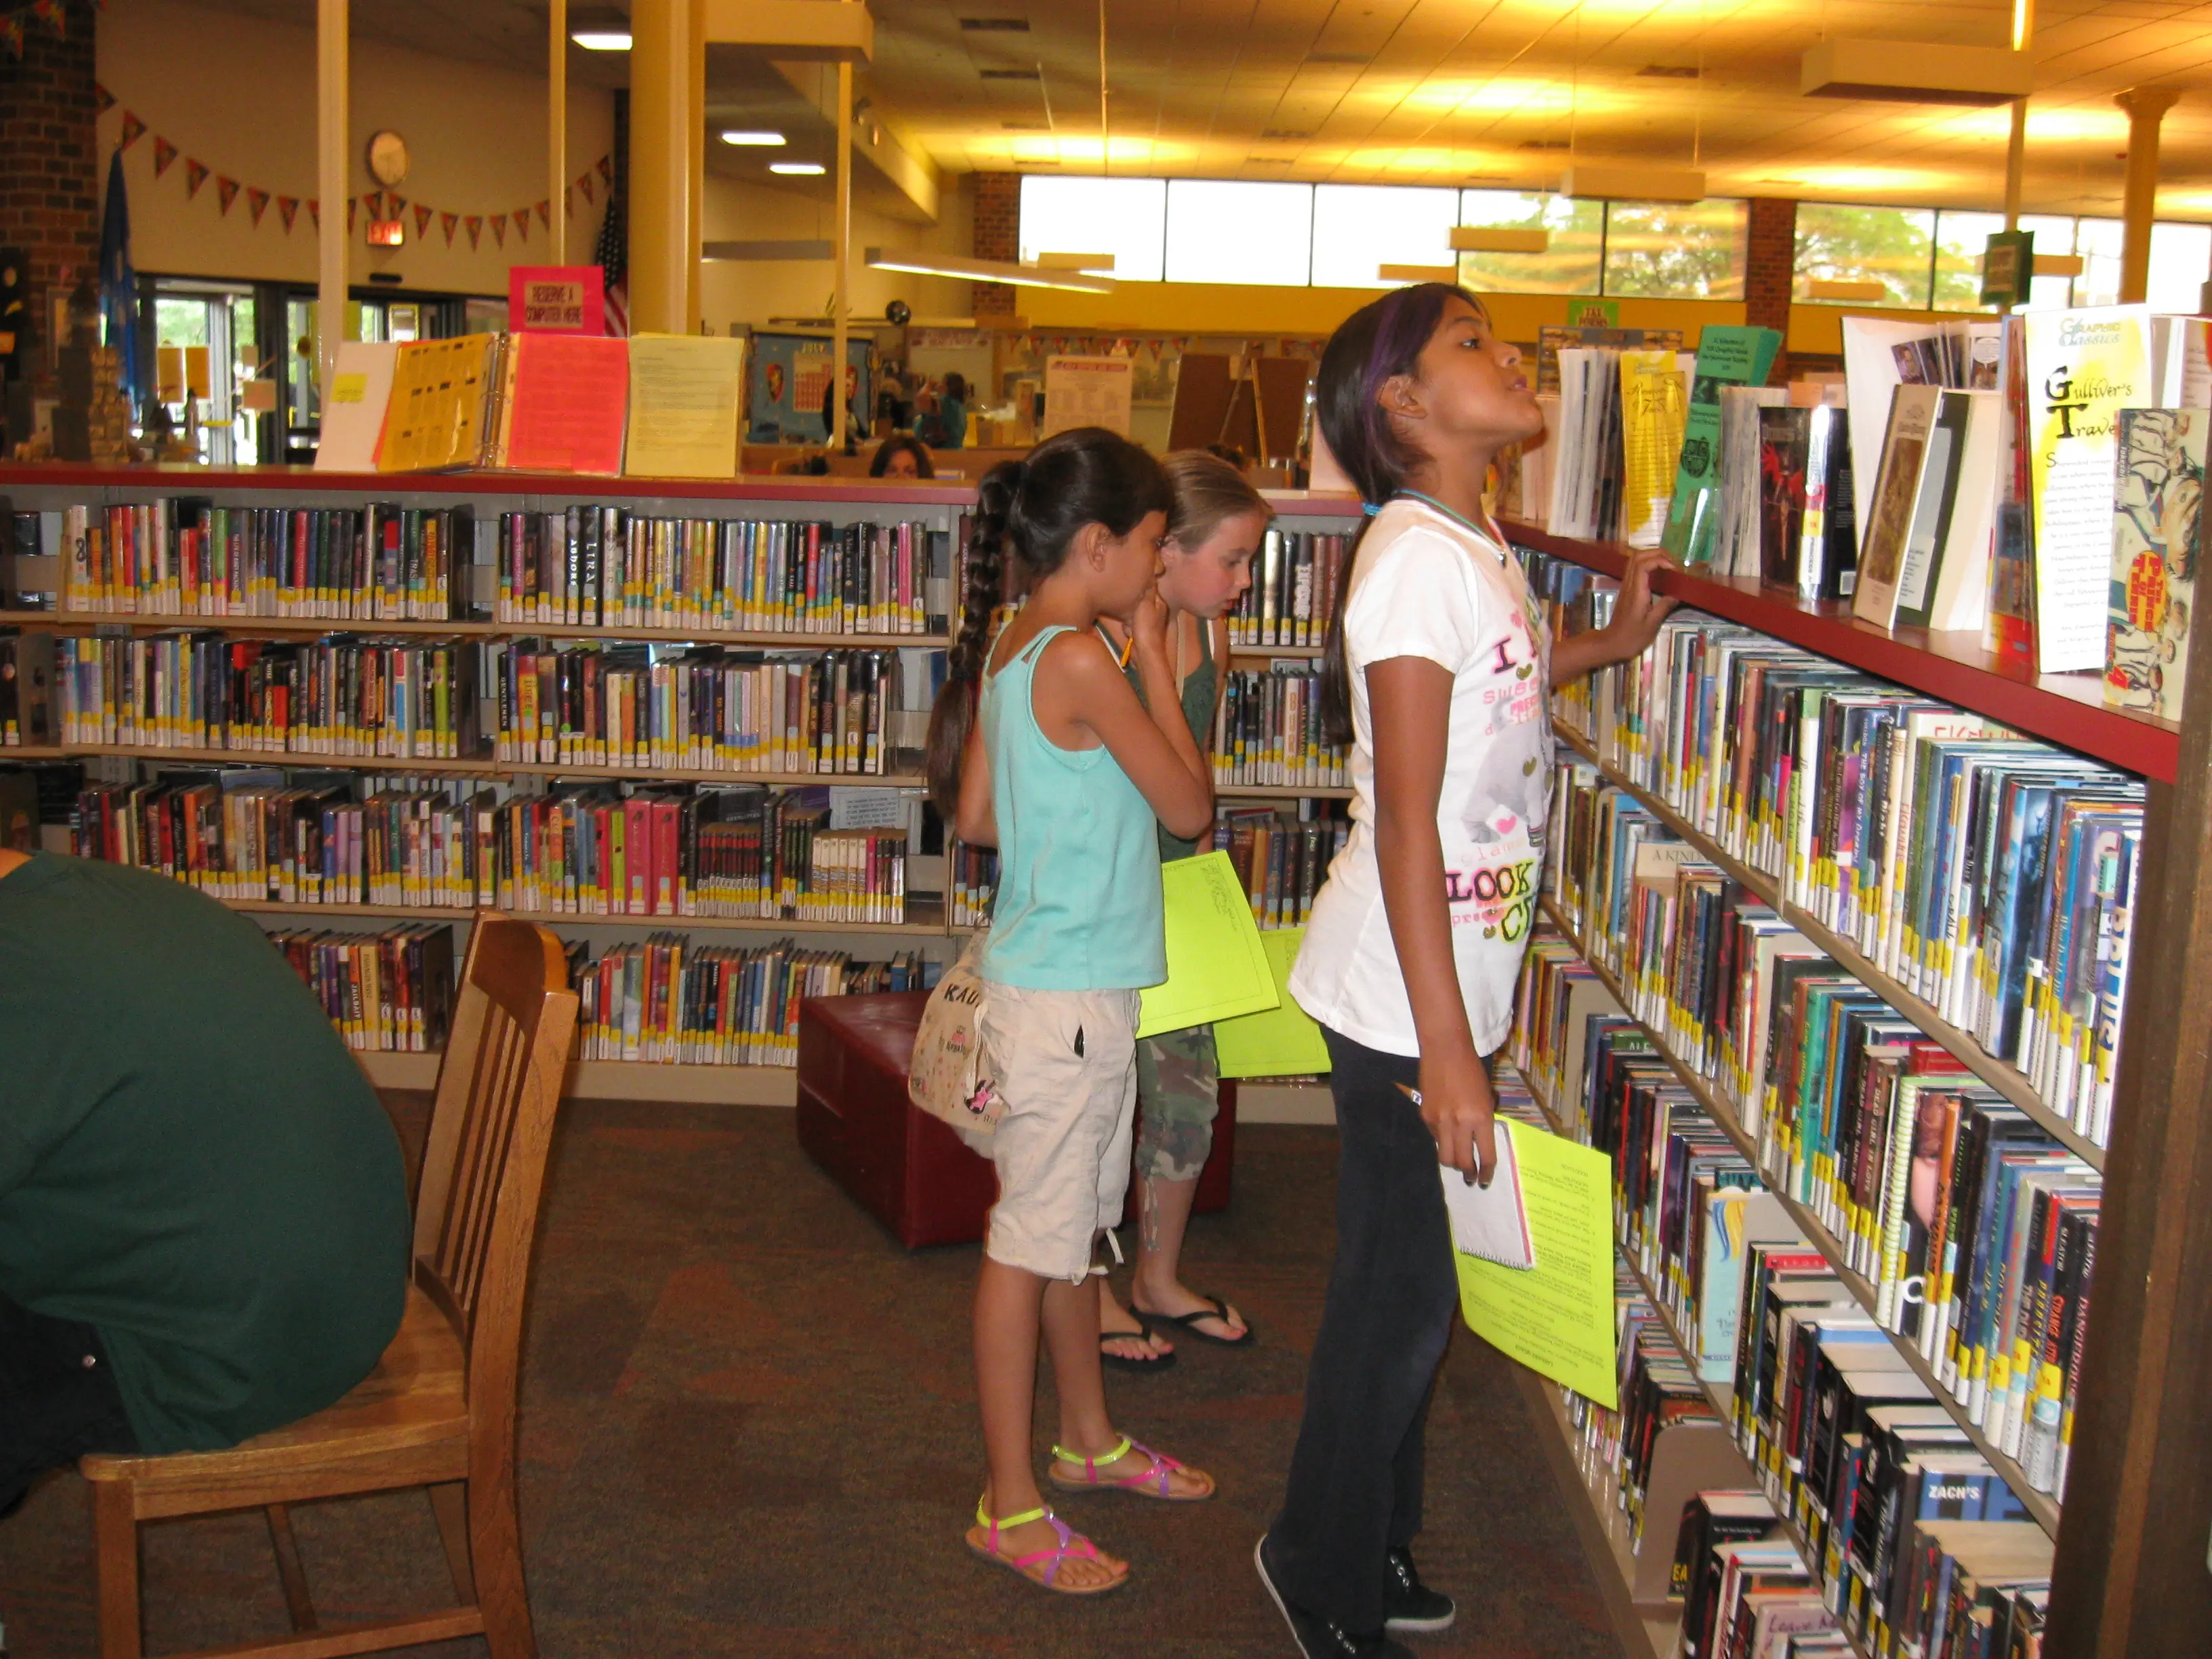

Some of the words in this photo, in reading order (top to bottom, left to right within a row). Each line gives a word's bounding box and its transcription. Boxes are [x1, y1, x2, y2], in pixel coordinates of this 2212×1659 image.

[2045, 366, 2132, 401] Gulliver's
[2046, 404, 2116, 438] Trave
[409, 559, 418, 581] TRAS
[569, 539, 577, 586] ABHORS
[586, 542, 596, 581] LIRA
[1446, 861, 1534, 903] LOOK
[1858, 1079, 1867, 1107] DEAD
[1872, 1087, 1881, 1115] DEAD
[1868, 1118, 1877, 1145] GIRL
[2048, 1294, 2064, 1338] STRANGE
